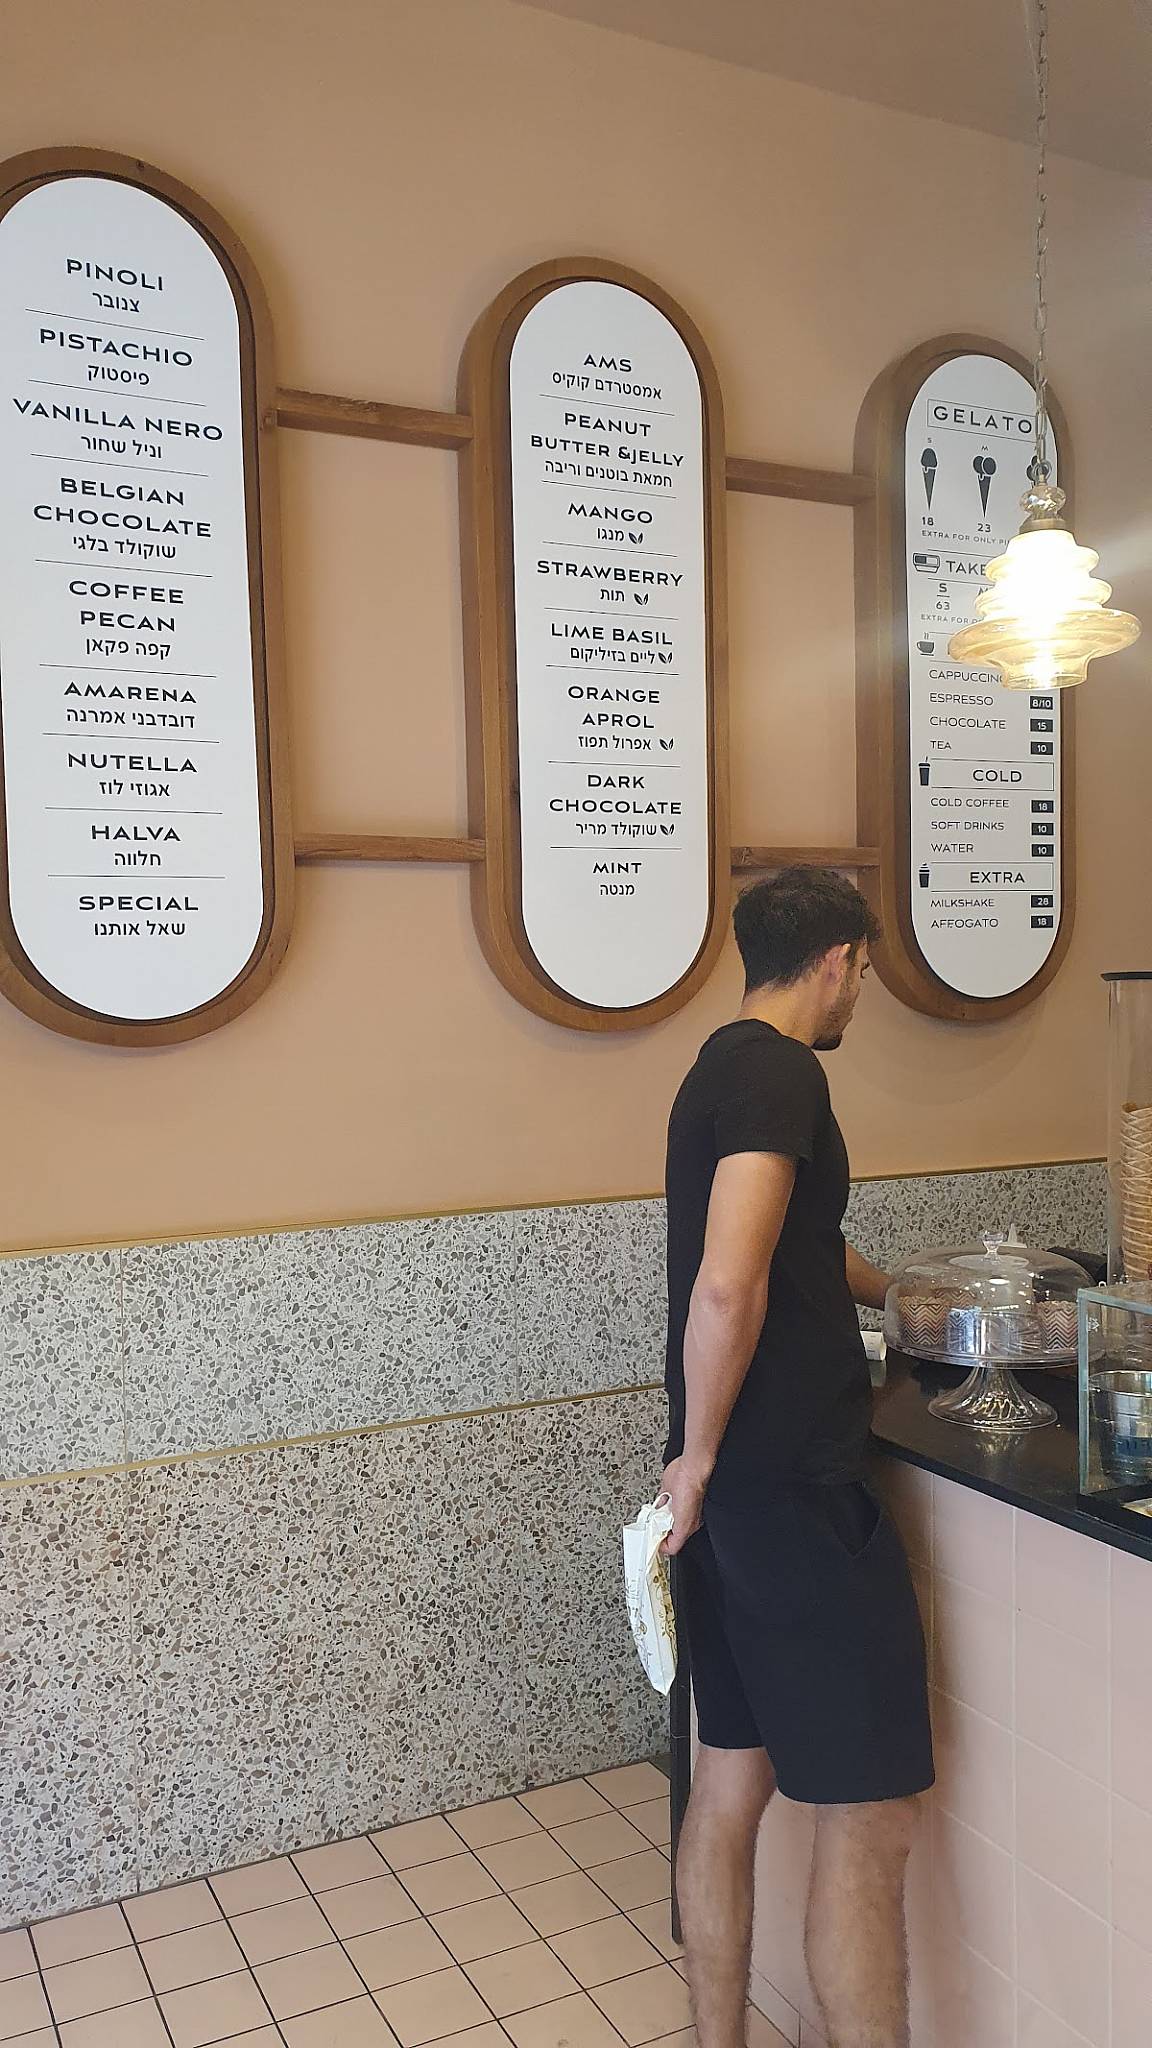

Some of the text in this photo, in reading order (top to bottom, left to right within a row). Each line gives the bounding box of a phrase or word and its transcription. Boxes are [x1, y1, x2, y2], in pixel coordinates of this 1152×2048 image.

[67, 259, 162, 290] PINOLI
[93, 293, 139, 312] צנובר
[39, 328, 193, 367] PISTACHIO
[584, 354, 631, 372] AMS
[88, 365, 149, 385] פיסטוק
[552, 371, 661, 399] אמסטרדם קוקיס
[13, 399, 222, 440] VANILLA NERO
[565, 413, 651, 436] PEANUT
[933, 406, 1032, 433] GELATO
[81, 436, 162, 459] וניל שחור
[532, 435, 683, 466] BUTTER &JELLY
[545, 460, 672, 488] חמאת בוטנים וריבה
[61, 478, 183, 505] BELGIAN
[34, 505, 211, 537] CHOCOLATE
[568, 504, 652, 523] MANGO
[921, 516, 934, 526] 18
[597, 527, 625, 542] מנגו
[977, 522, 991, 533] 23
[921, 529, 950, 539] EXTRA
[952, 533, 970, 541] FOR
[973, 535, 997, 545] ONLY
[73, 534, 175, 559] שוקולד בלגי
[538, 561, 683, 586] STRAWBERRY
[69, 581, 183, 604] COFFEE
[600, 588, 625, 602] תות
[938, 582, 948, 593] S
[935, 600, 950, 611] 63
[81, 611, 174, 631] PECAN
[552, 623, 672, 645] LIME BASIL
[87, 639, 171, 661] קפה פקאן
[571, 647, 656, 665] ליים בזיליקום
[64, 682, 196, 703] AMARENA
[568, 686, 659, 703] ORANGE
[929, 692, 1051, 708] ESPRESSO 8/10
[67, 709, 194, 728] דובדבני אמרנה
[583, 713, 654, 728] APROL
[929, 716, 1047, 730] CHOCOLATE 15
[577, 734, 652, 751] אפרול תפוז
[929, 740, 952, 750] TEA
[69, 754, 197, 772] NUTELLA
[587, 774, 645, 789] DARK
[972, 769, 1022, 783] COLD
[99, 778, 171, 797] אגוזי לוז
[550, 799, 681, 814] CHOCOLATE
[930, 797, 963, 807] COLD
[965, 798, 1010, 808] COFFEE
[92, 826, 180, 841] HALVA
[575, 822, 656, 838] שוקולד מריר
[931, 821, 1047, 833] SOFT DRINKS 10
[930, 843, 974, 853] WATER
[114, 850, 161, 866] חלווה
[592, 862, 642, 874] MINT
[970, 871, 1025, 884] EXTRA
[599, 884, 635, 896] מנטה
[79, 895, 199, 911] SPECIAL
[930, 898, 1048, 908] MILKSHAKE 28
[94, 919, 186, 936] שאל אותנו
[930, 918, 1047, 929] AFFOGATO 18
